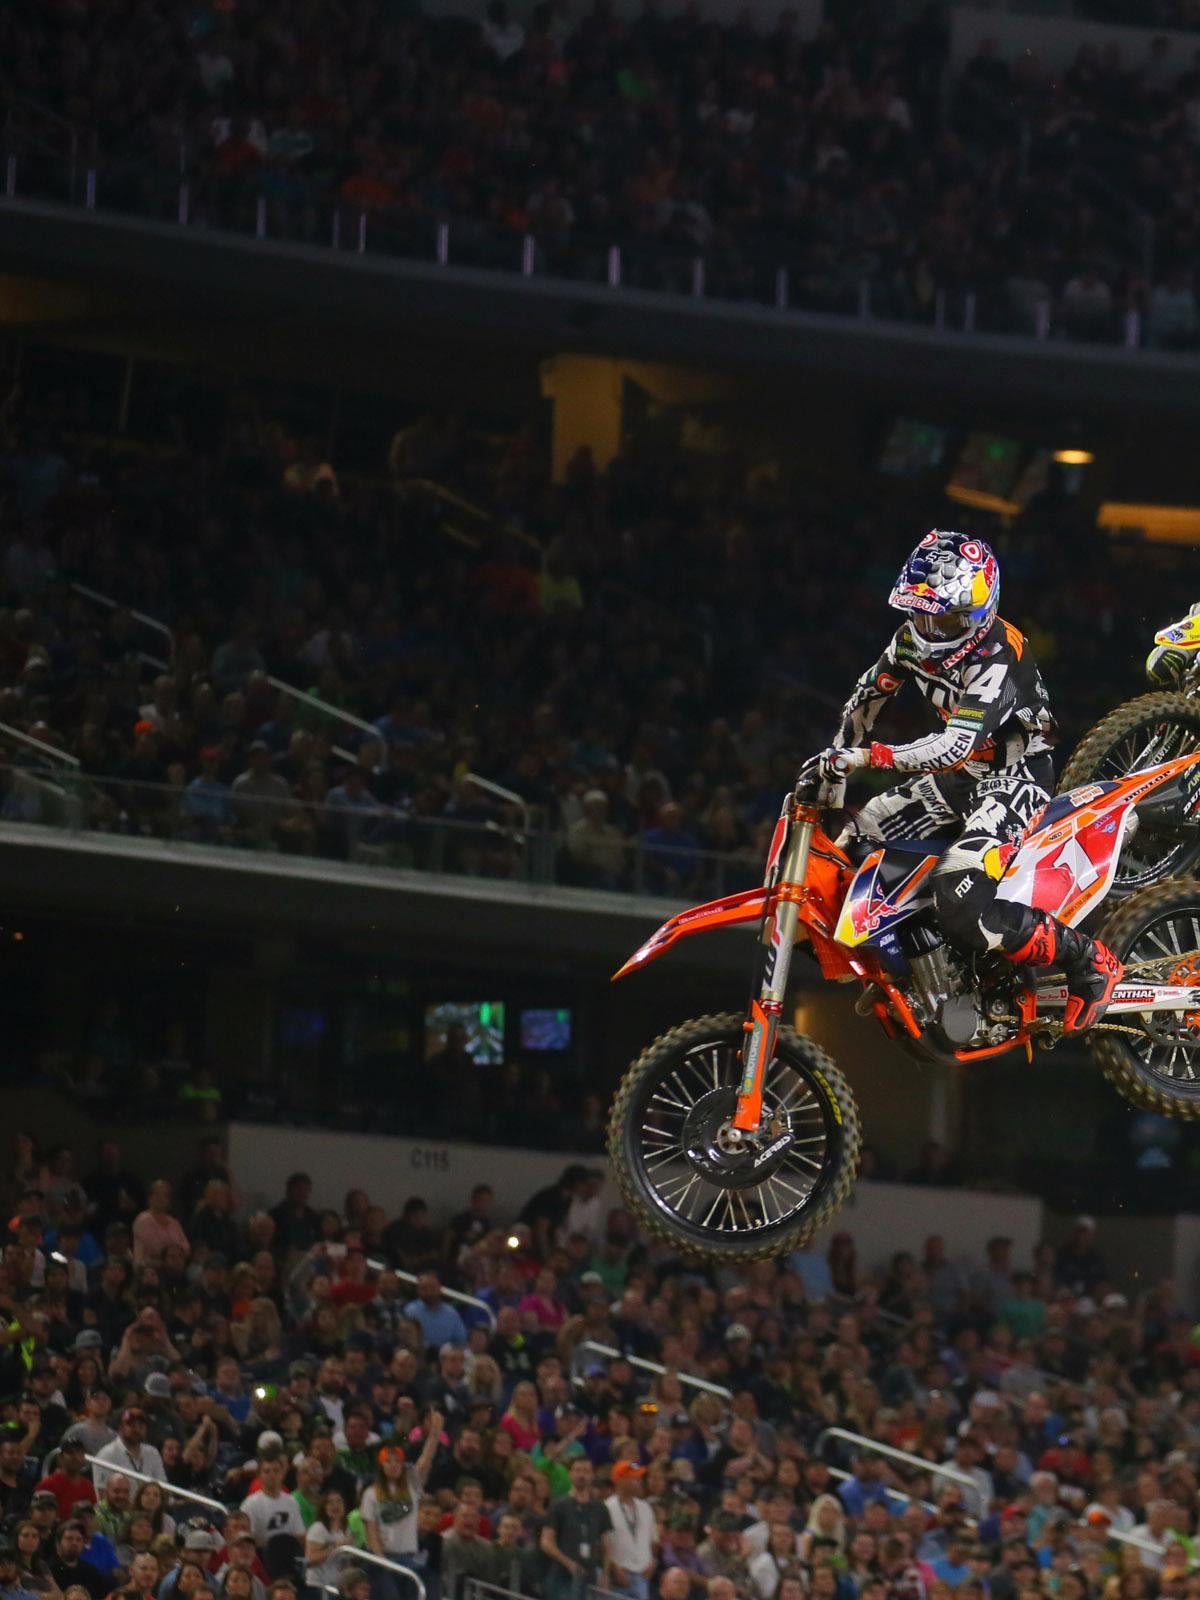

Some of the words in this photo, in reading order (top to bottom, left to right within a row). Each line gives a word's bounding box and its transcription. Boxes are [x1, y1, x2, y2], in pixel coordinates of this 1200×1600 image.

[920, 732, 972, 770] SIXTEEN
[1124, 770, 1171, 802] DUNLOP
[954, 874, 975, 898] FOX
[1112, 989, 1154, 999] ENTHAL
